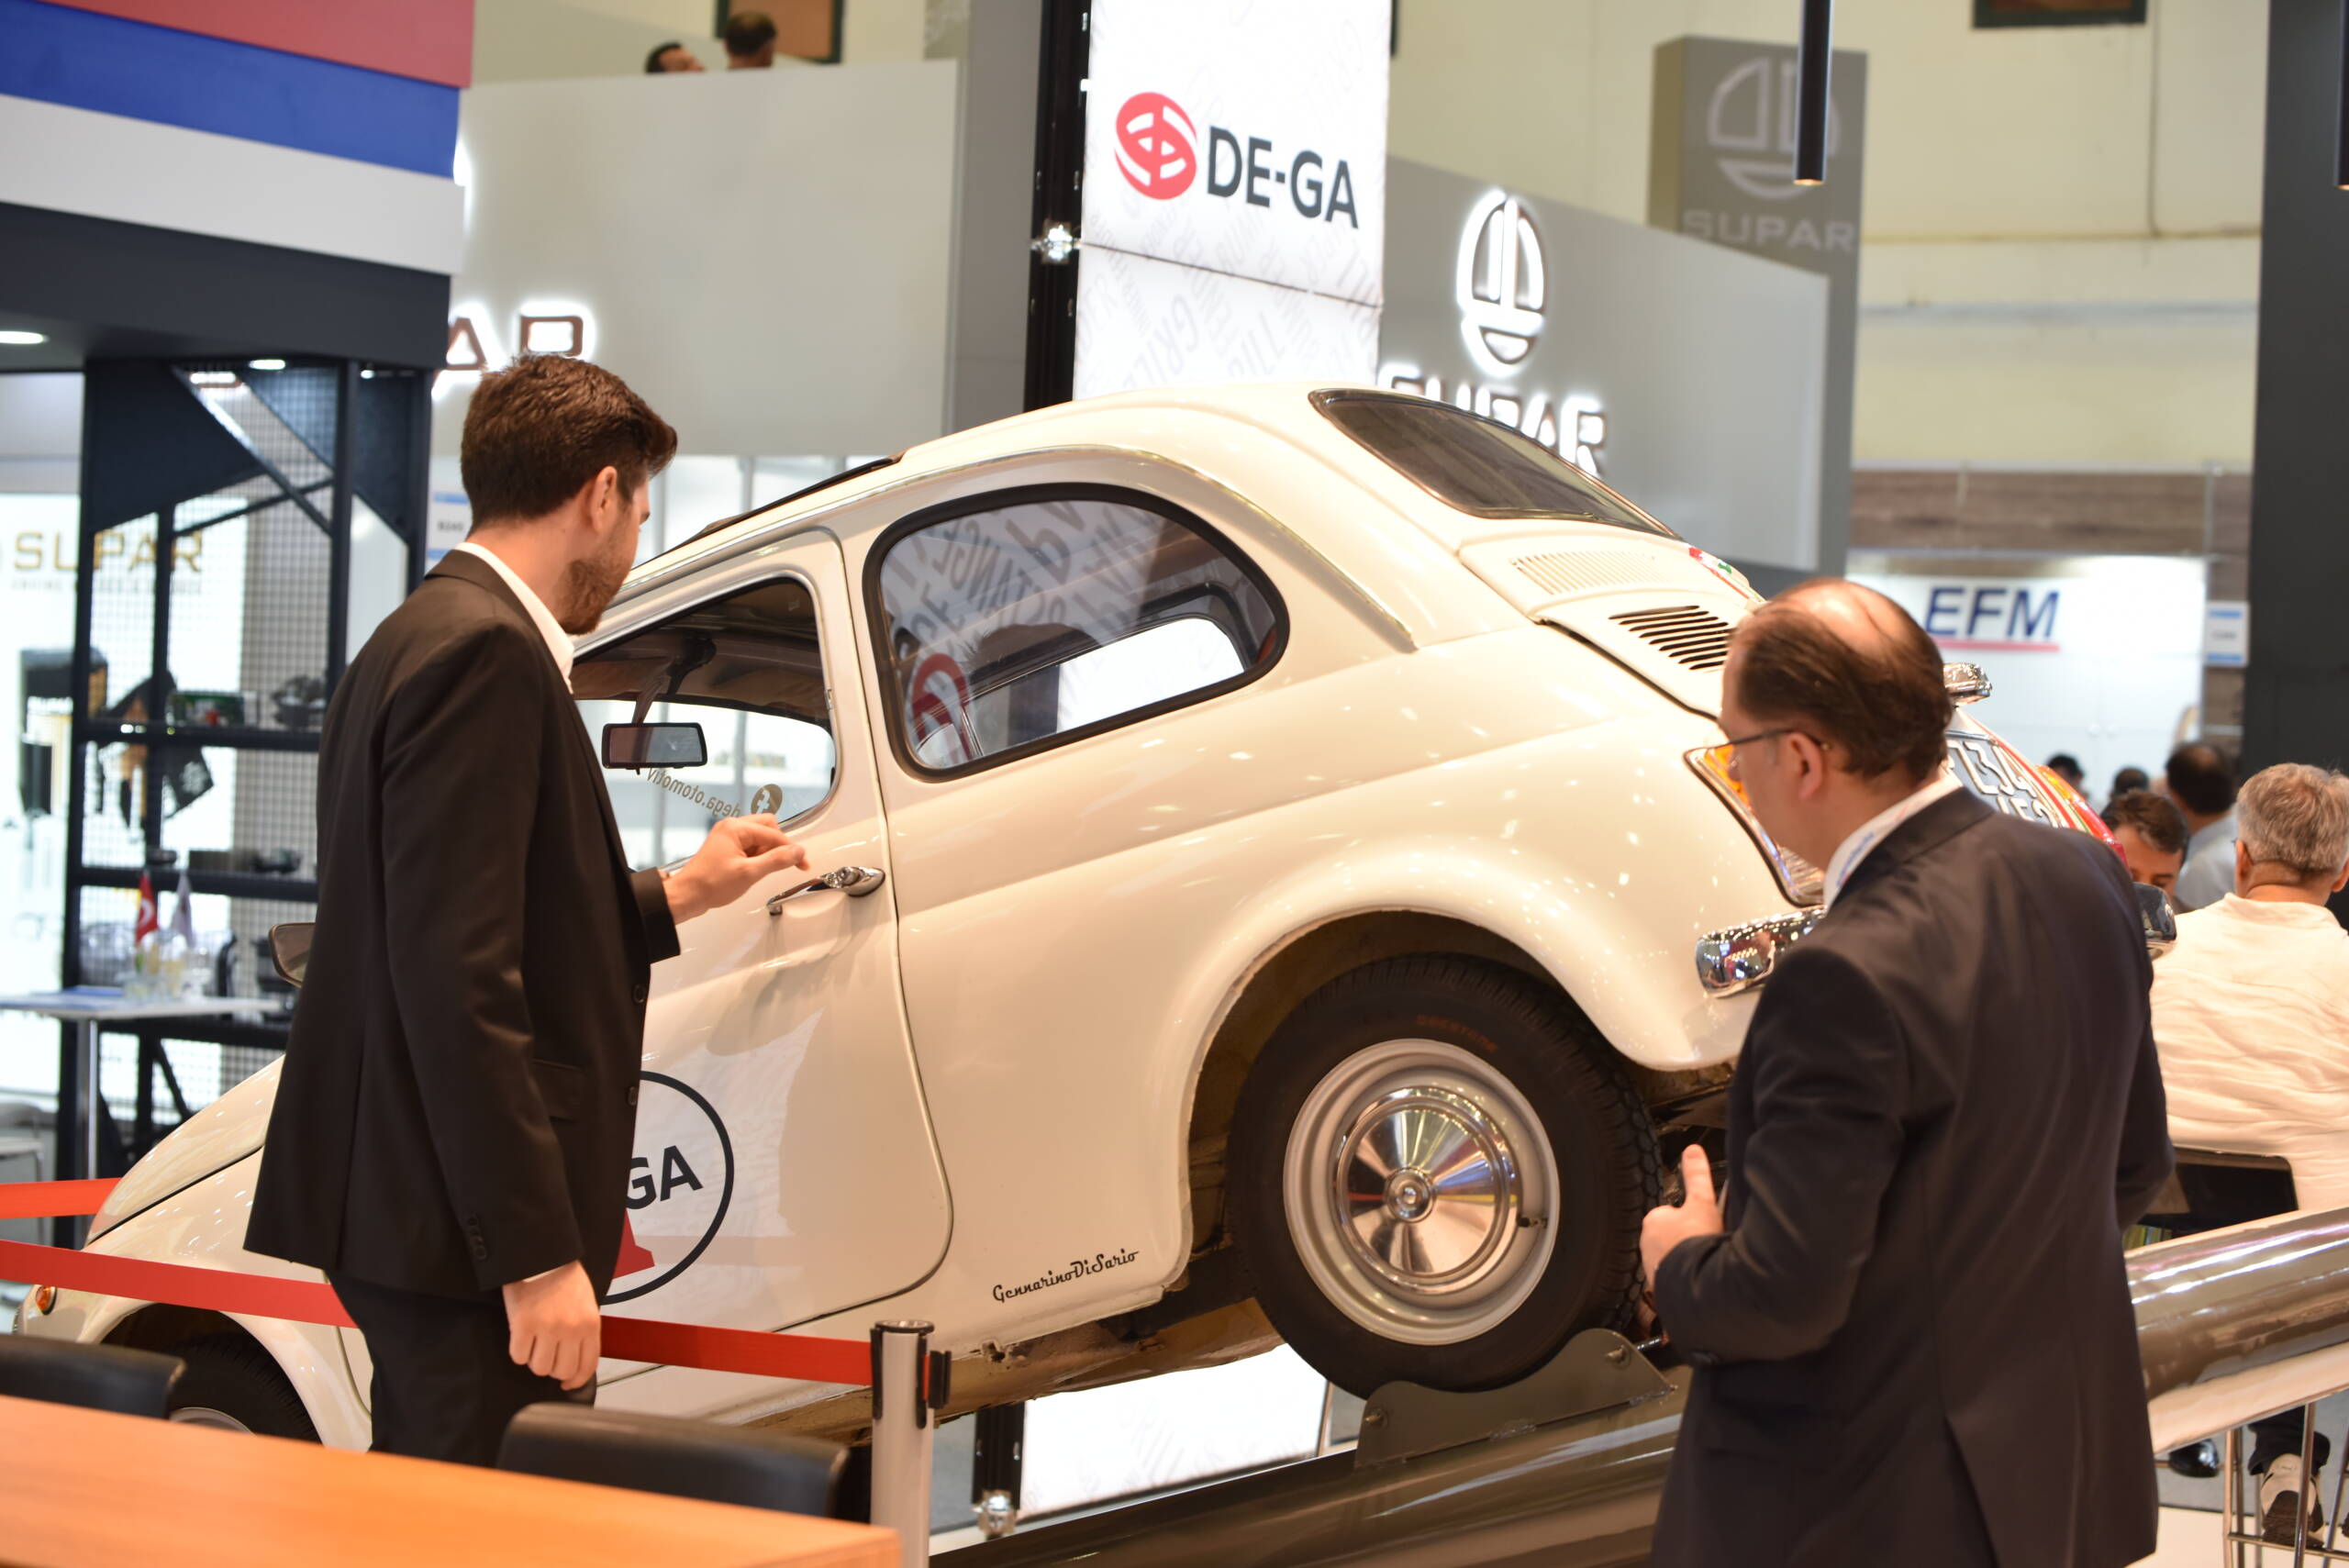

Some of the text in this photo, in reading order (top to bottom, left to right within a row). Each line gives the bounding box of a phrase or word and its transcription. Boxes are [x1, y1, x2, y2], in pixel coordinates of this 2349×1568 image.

[1207, 125, 1359, 229] DE-GA
[1682, 209, 1856, 255] SUPAR
[1925, 586, 2060, 638] EFM
